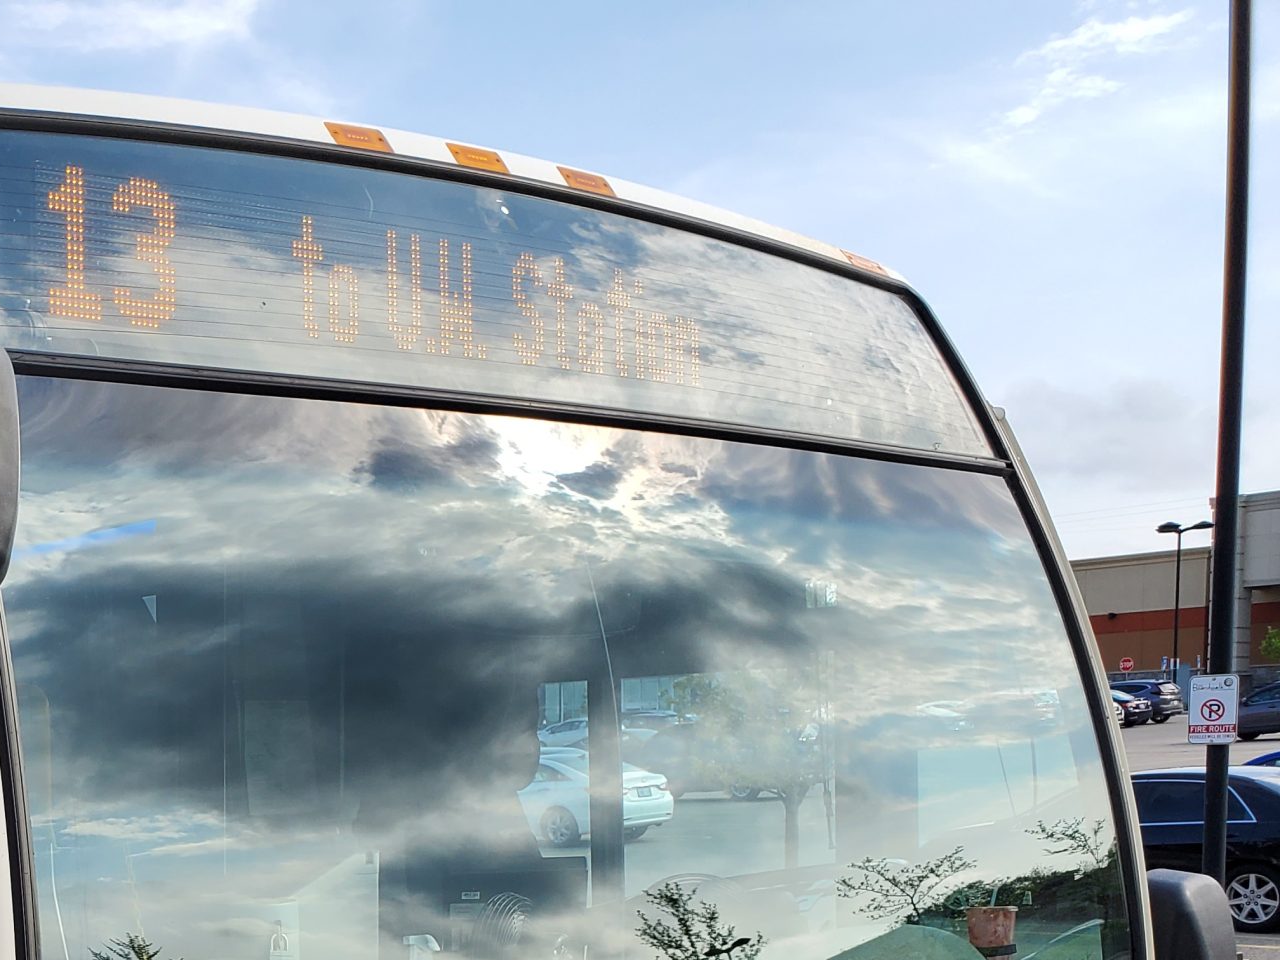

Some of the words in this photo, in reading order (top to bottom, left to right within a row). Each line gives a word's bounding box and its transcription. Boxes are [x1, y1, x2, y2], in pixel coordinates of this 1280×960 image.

[48, 165, 177, 329] 13
[292, 214, 360, 343] to
[512, 251, 701, 387] Station
[1120, 661, 1134, 669] STOP
